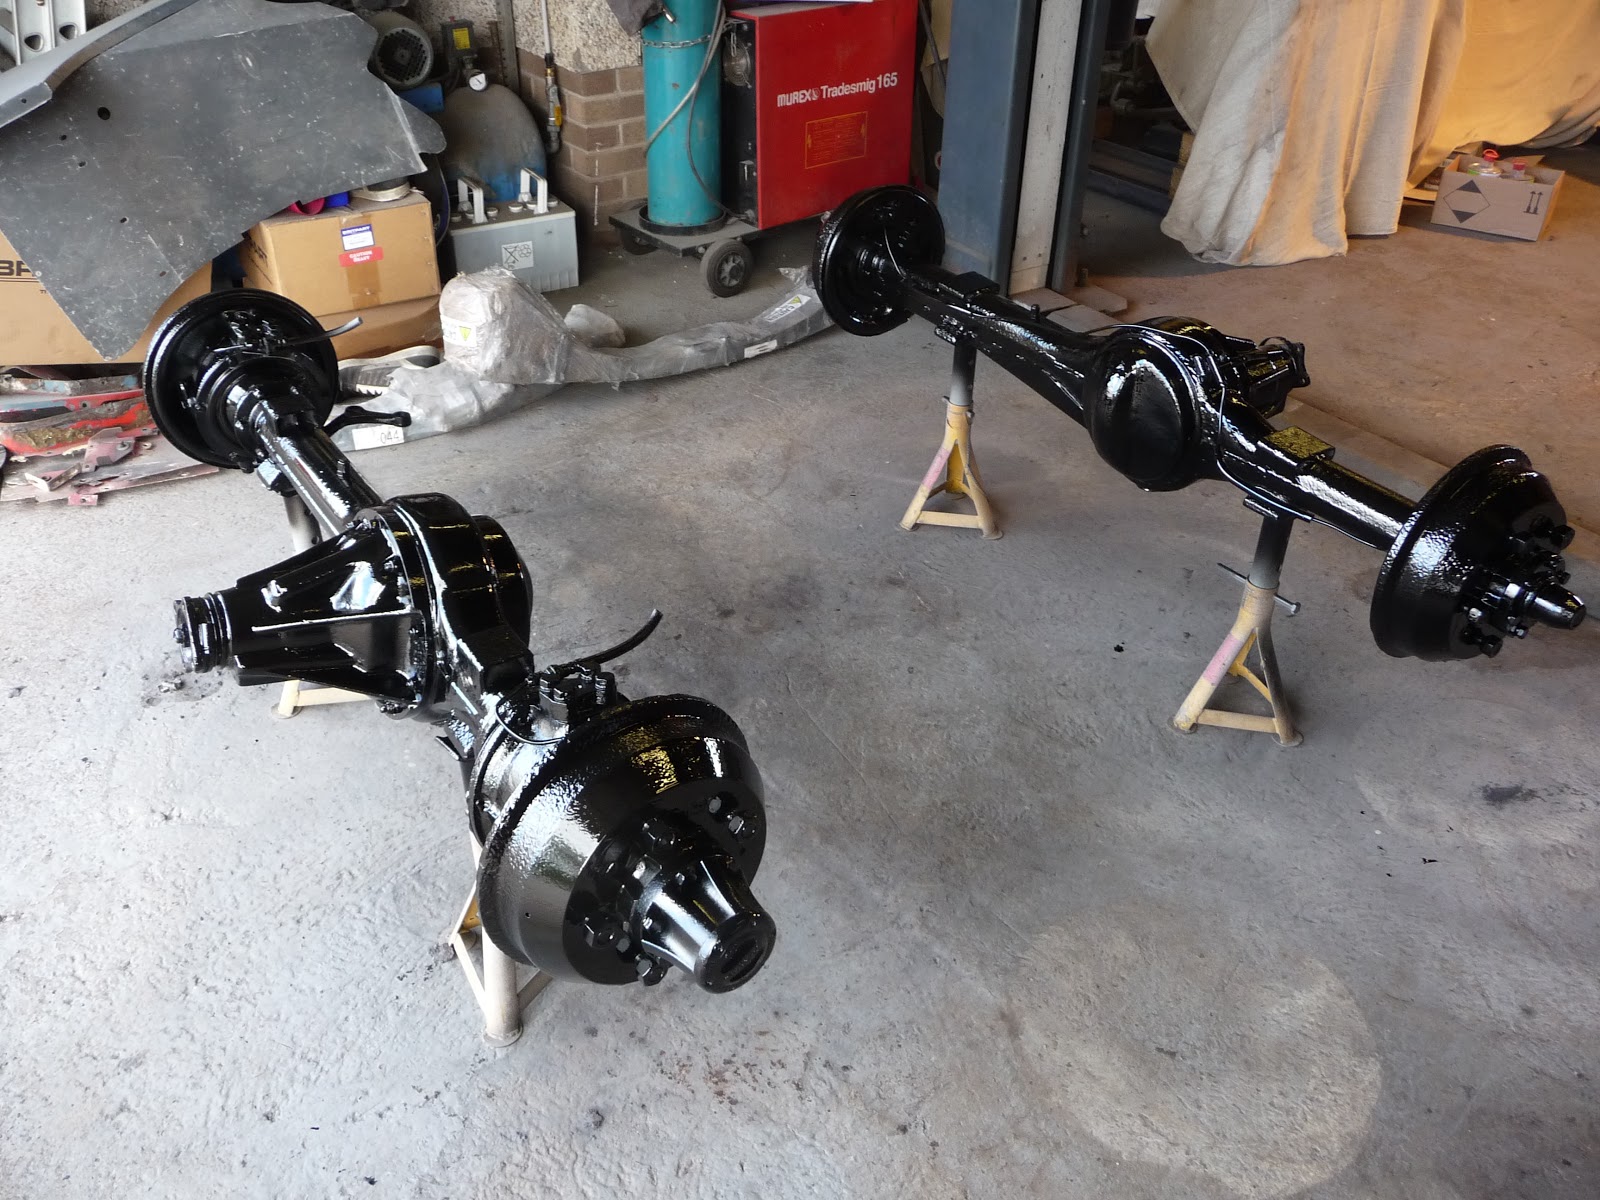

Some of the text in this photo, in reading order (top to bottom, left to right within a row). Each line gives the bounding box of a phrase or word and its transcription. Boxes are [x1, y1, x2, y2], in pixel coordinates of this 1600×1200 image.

[777, 72, 898, 107] MUREX Tradesmig 165
